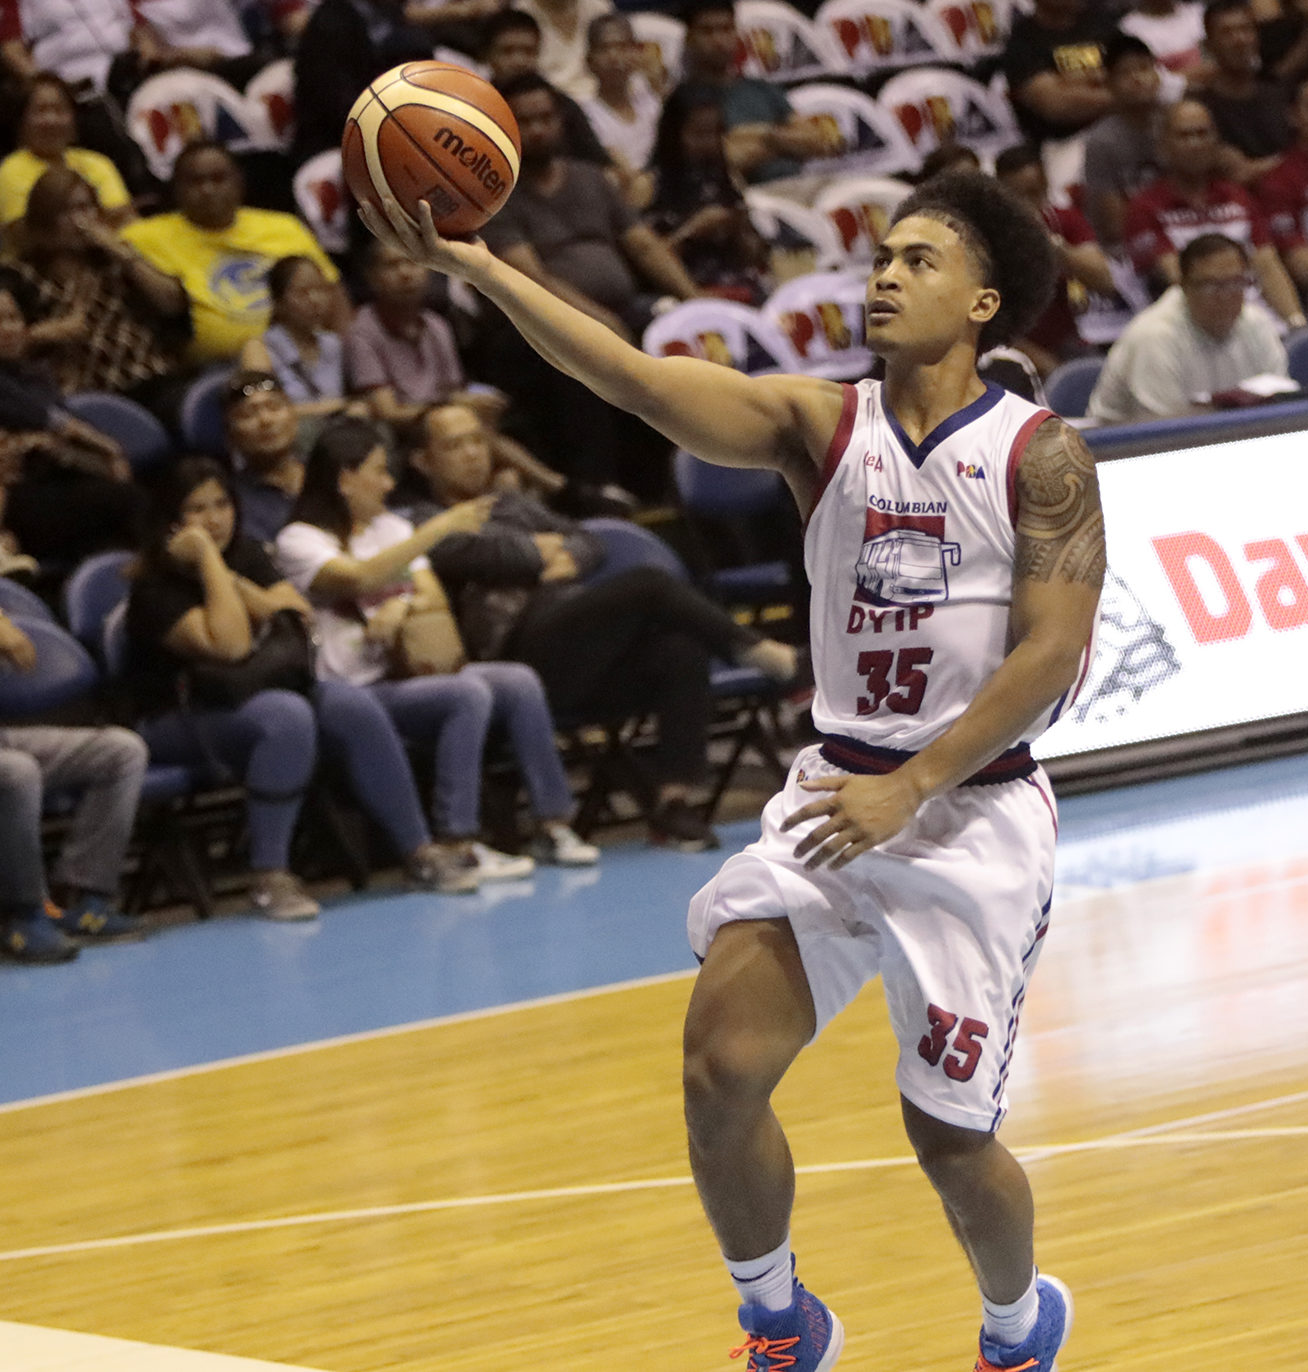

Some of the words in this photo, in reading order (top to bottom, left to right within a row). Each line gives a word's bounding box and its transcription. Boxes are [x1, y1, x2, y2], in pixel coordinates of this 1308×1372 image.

[433, 127, 506, 200] molten
[869, 494, 948, 514] COLUMBIAN
[846, 604, 935, 635] DYIP
[855, 647, 934, 717] 35
[917, 1002, 989, 1083] 35
